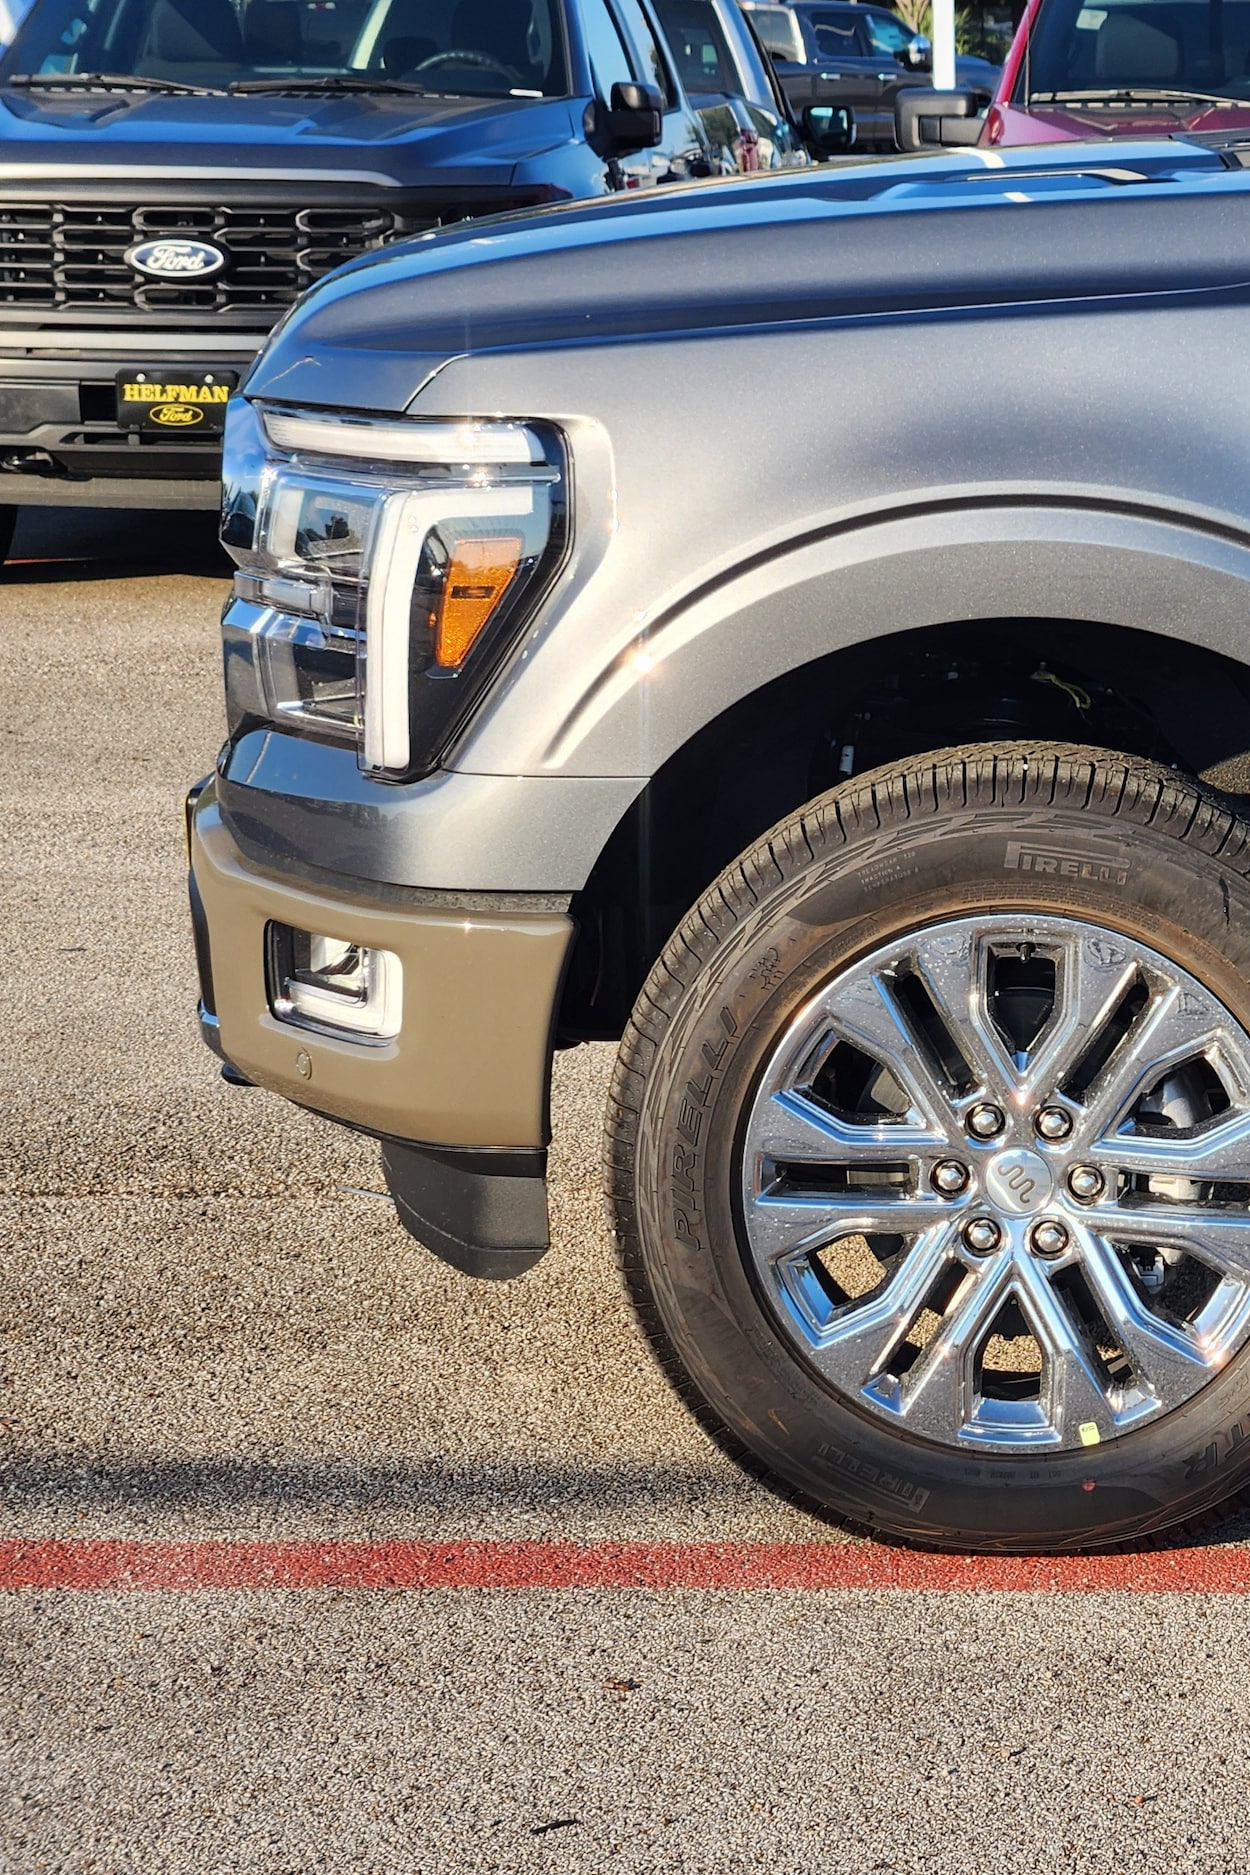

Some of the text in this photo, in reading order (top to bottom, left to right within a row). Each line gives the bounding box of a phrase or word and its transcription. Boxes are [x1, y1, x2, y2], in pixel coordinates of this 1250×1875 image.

[147, 245, 205, 271] Ford
[123, 383, 230, 403] HELFMAN
[158, 405, 194, 422] Ford
[1003, 840, 1131, 886] PIRELLI
[671, 1005, 738, 1251] PIRELLI
[817, 1441, 931, 1514] PIRELLI
